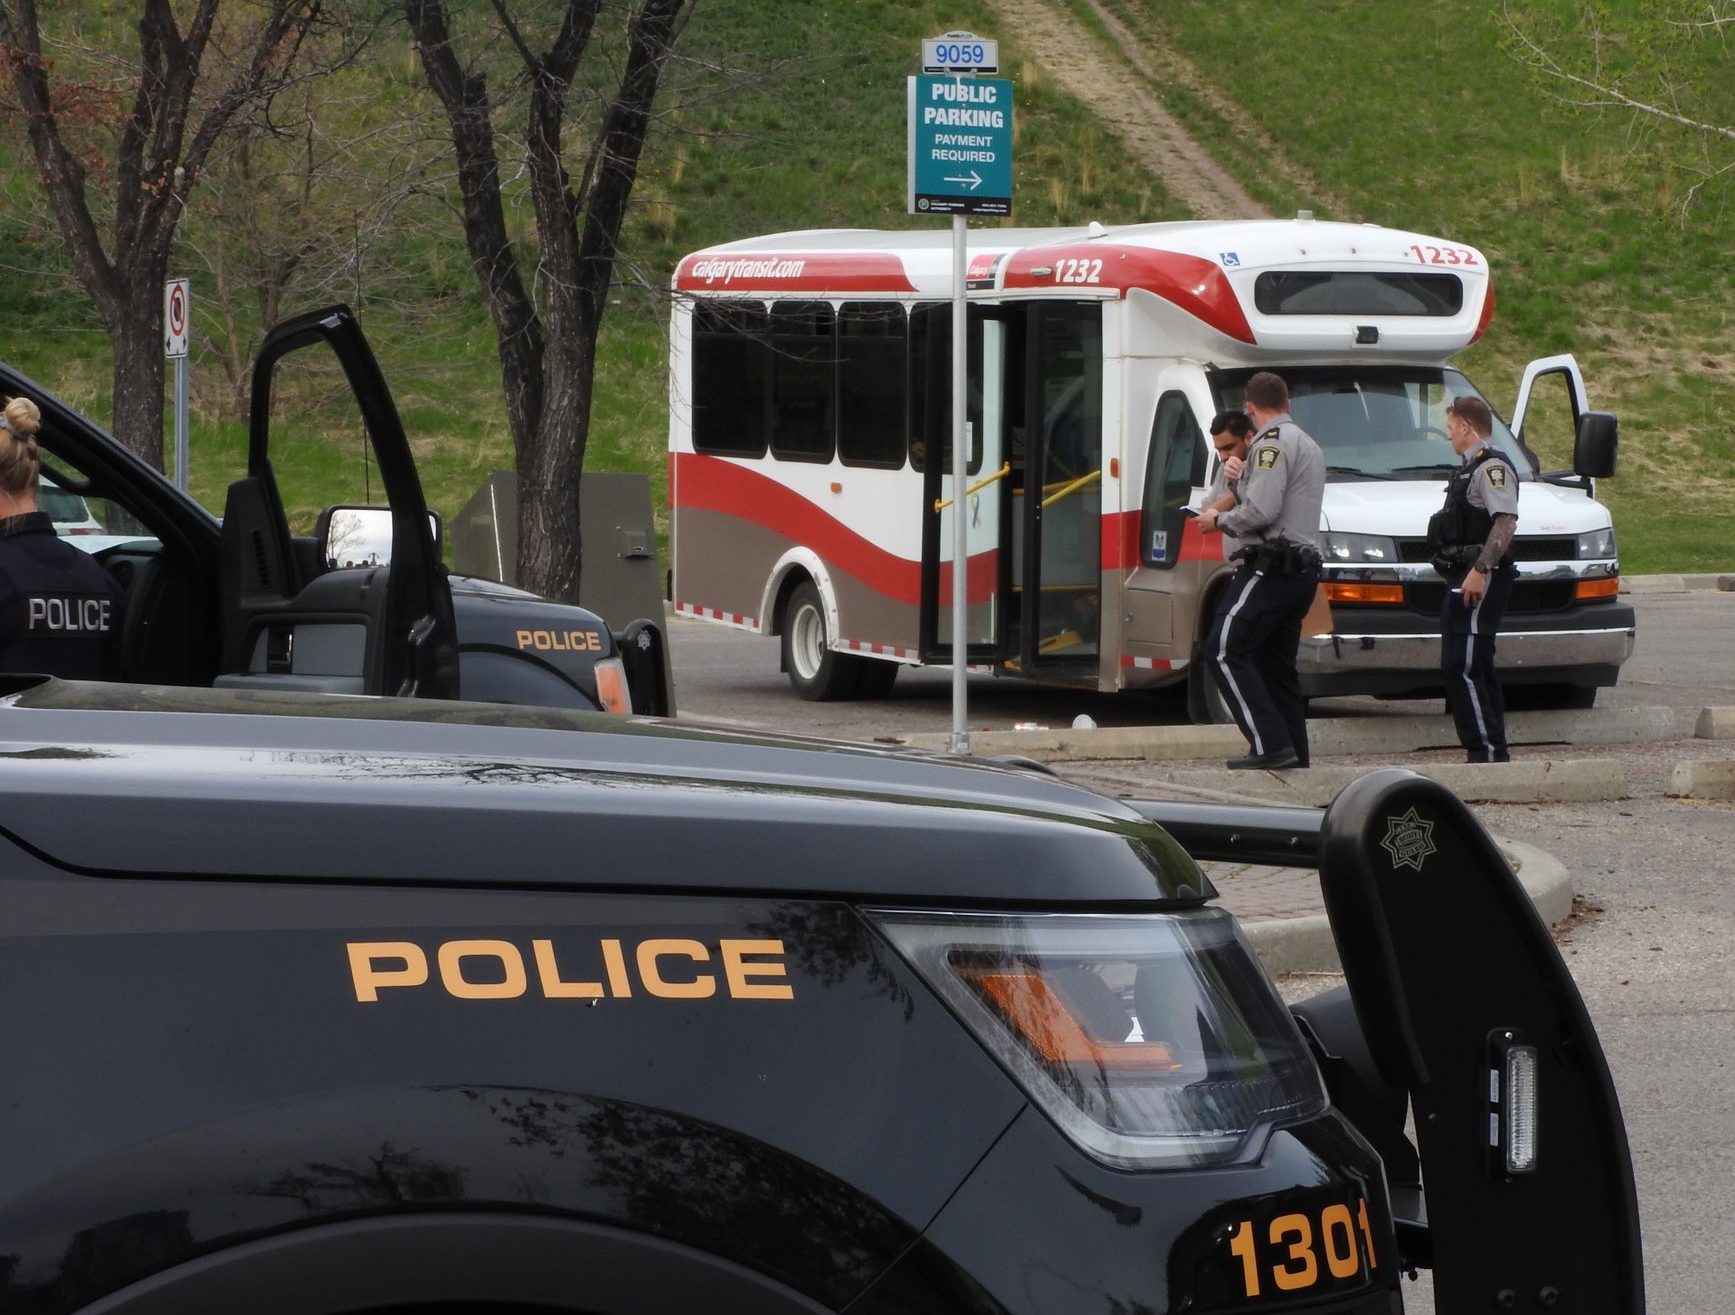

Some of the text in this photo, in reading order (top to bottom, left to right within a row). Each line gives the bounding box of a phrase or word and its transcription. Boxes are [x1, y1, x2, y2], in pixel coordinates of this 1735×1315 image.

[936, 44, 984, 63] 9059
[932, 83, 997, 103] PUBLIC
[924, 107, 1004, 128] PARKING
[935, 133, 993, 147] PAYMENT
[931, 149, 996, 163] REQUIRED
[1410, 244, 1479, 265] 1232
[692, 256, 805, 285] calgarytransit.com
[1055, 258, 1103, 284] 1232
[28, 597, 111, 631] POLICE
[517, 630, 601, 652] POLICE
[346, 939, 794, 1002] POLICE
[1230, 1197, 1377, 1297] 1301
